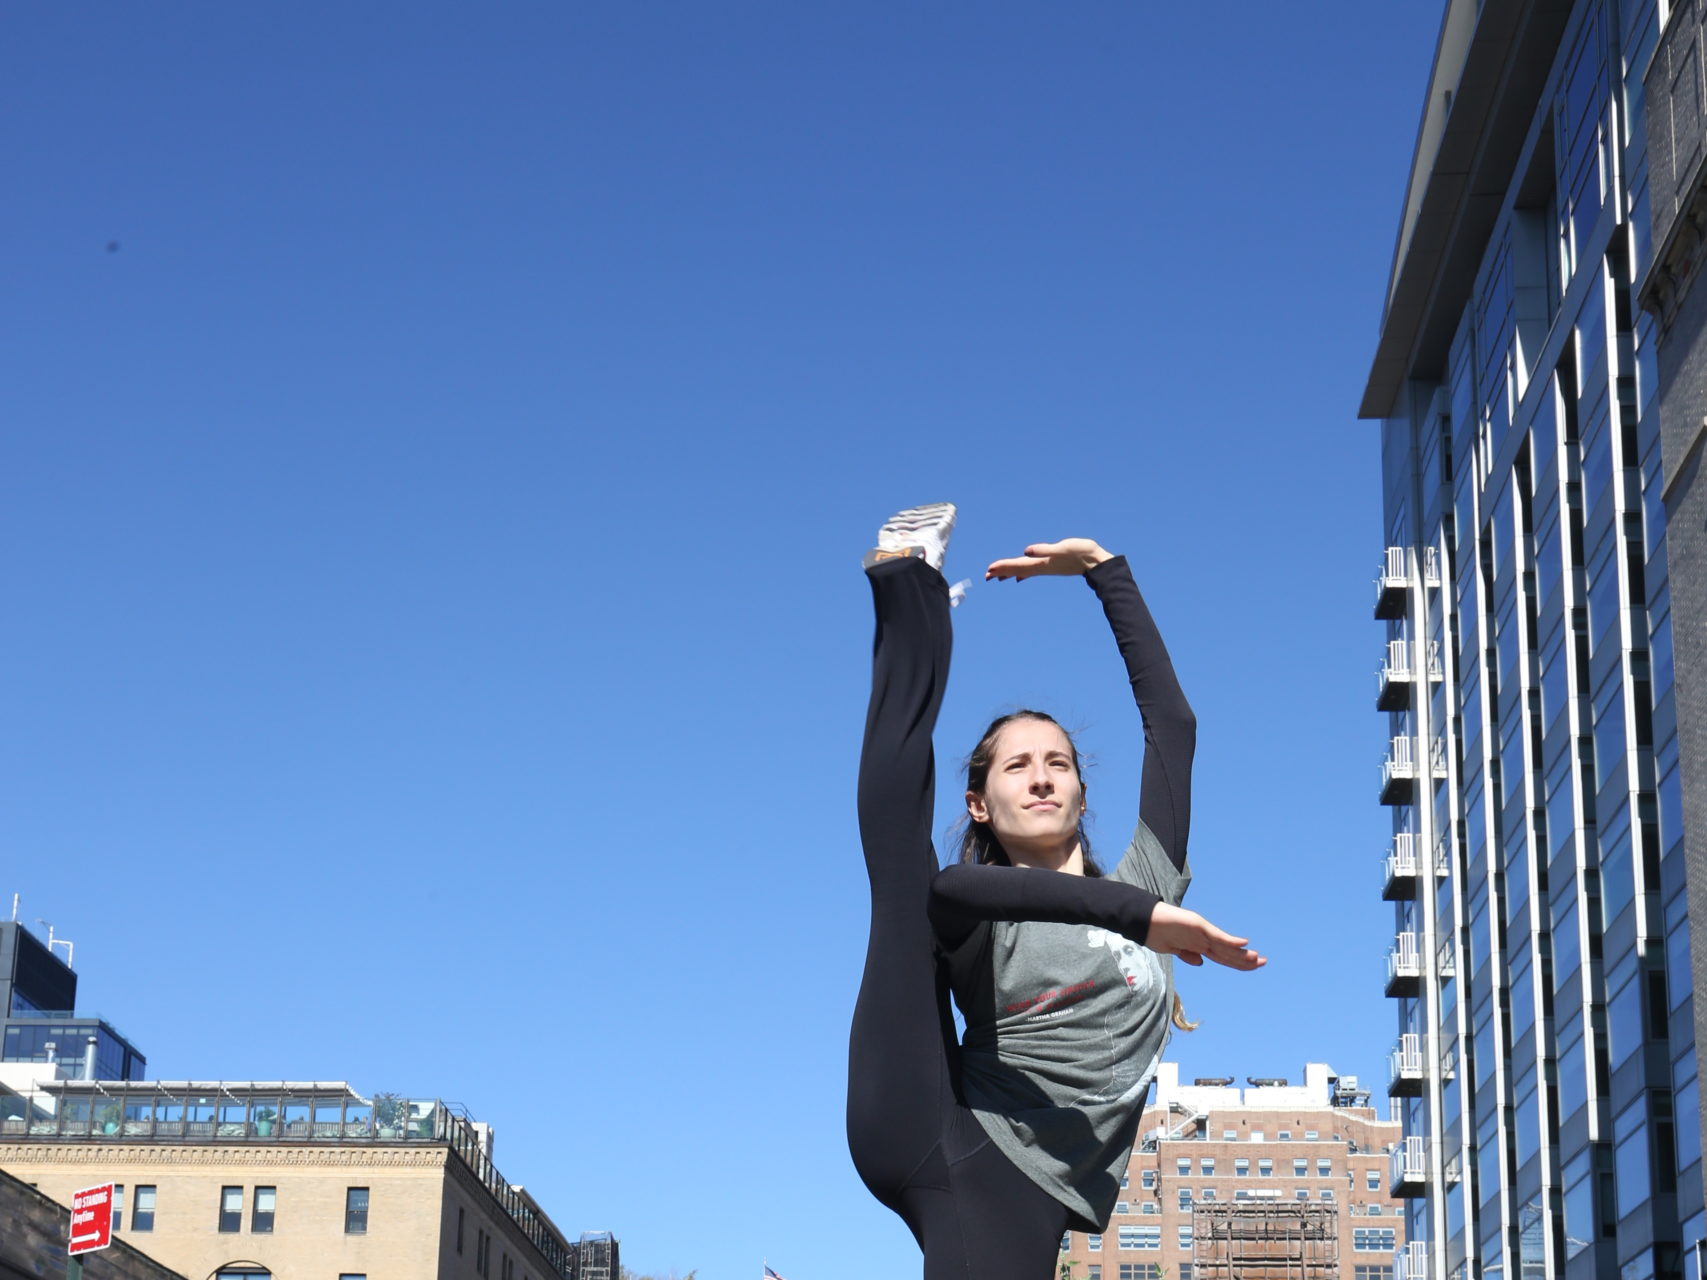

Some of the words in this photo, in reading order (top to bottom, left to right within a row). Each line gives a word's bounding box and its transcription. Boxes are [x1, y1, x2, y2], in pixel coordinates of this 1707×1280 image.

[74, 1197, 82, 1210] NO
[82, 1190, 108, 1208] STANDING
[73, 1210, 95, 1225] Anytime
